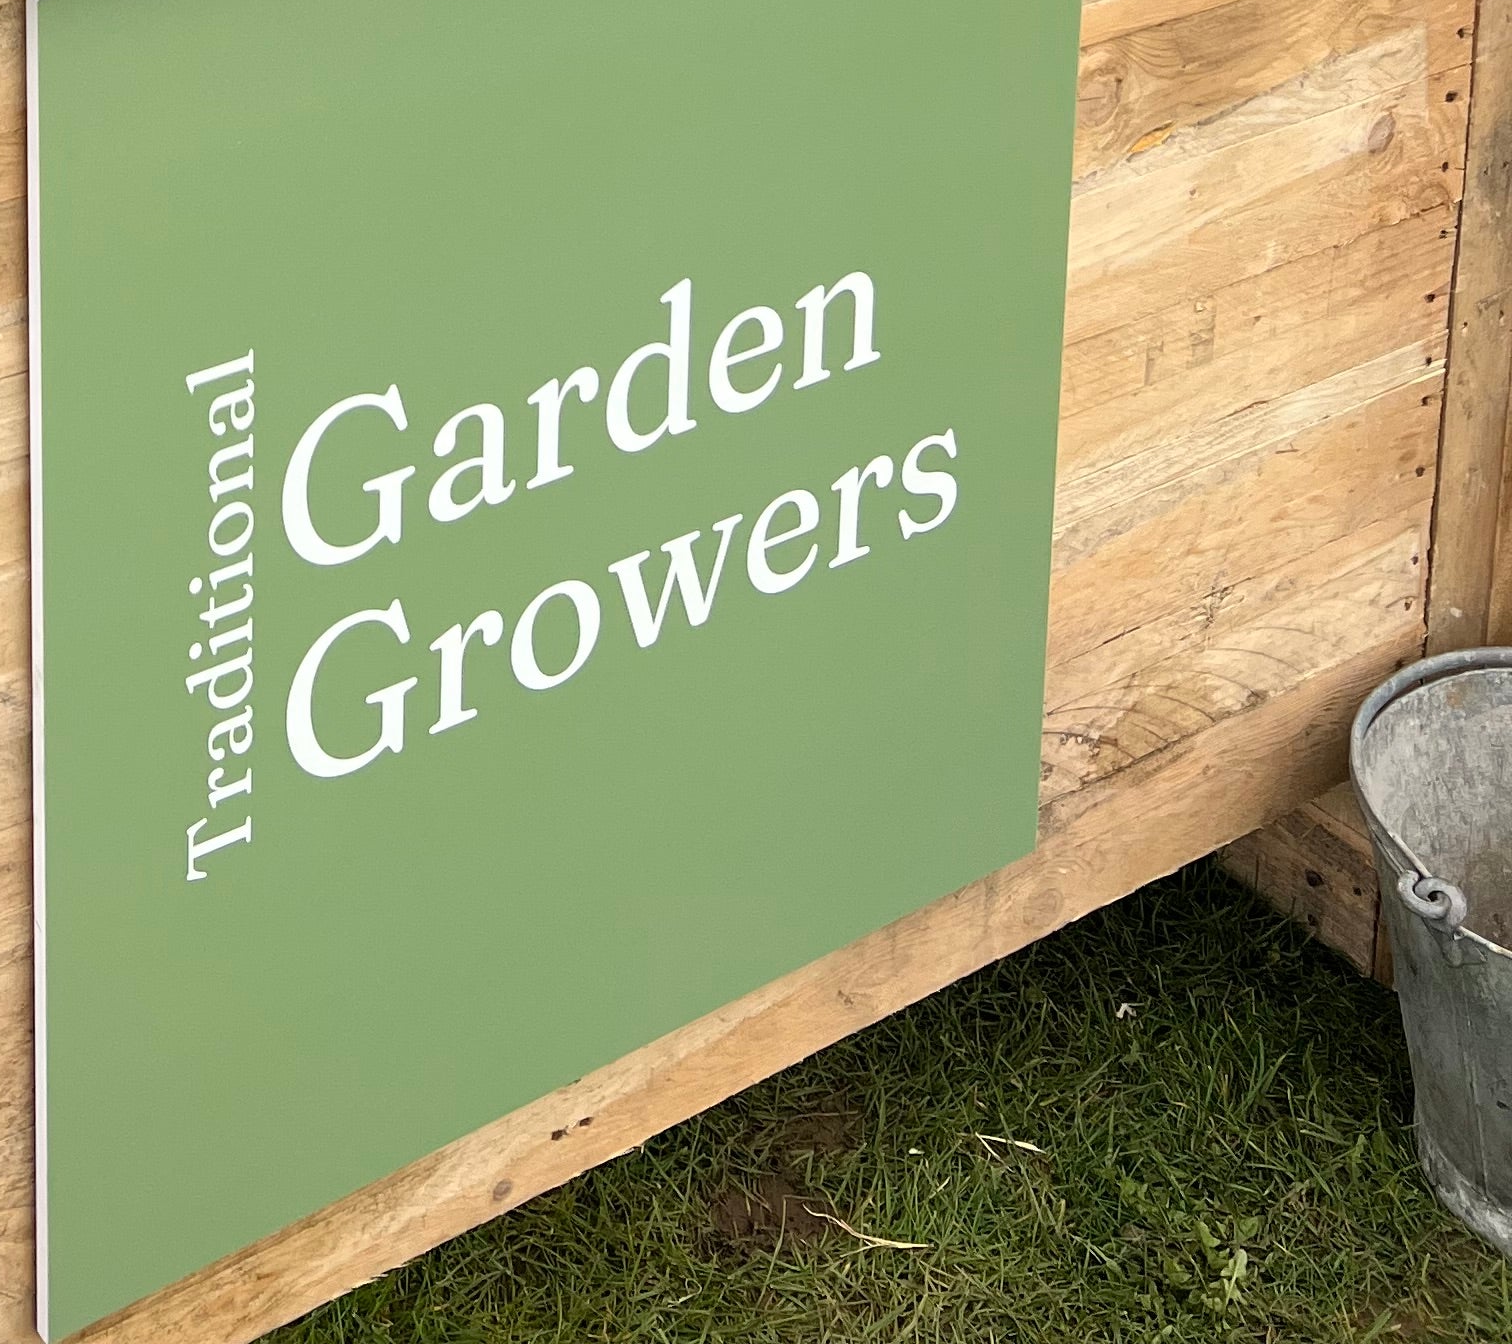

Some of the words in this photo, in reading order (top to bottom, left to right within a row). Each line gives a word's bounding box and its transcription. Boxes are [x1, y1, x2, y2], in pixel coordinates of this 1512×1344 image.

[280, 270, 882, 566] Garden
[184, 348, 254, 882] Traditional
[284, 428, 960, 779] Growers
